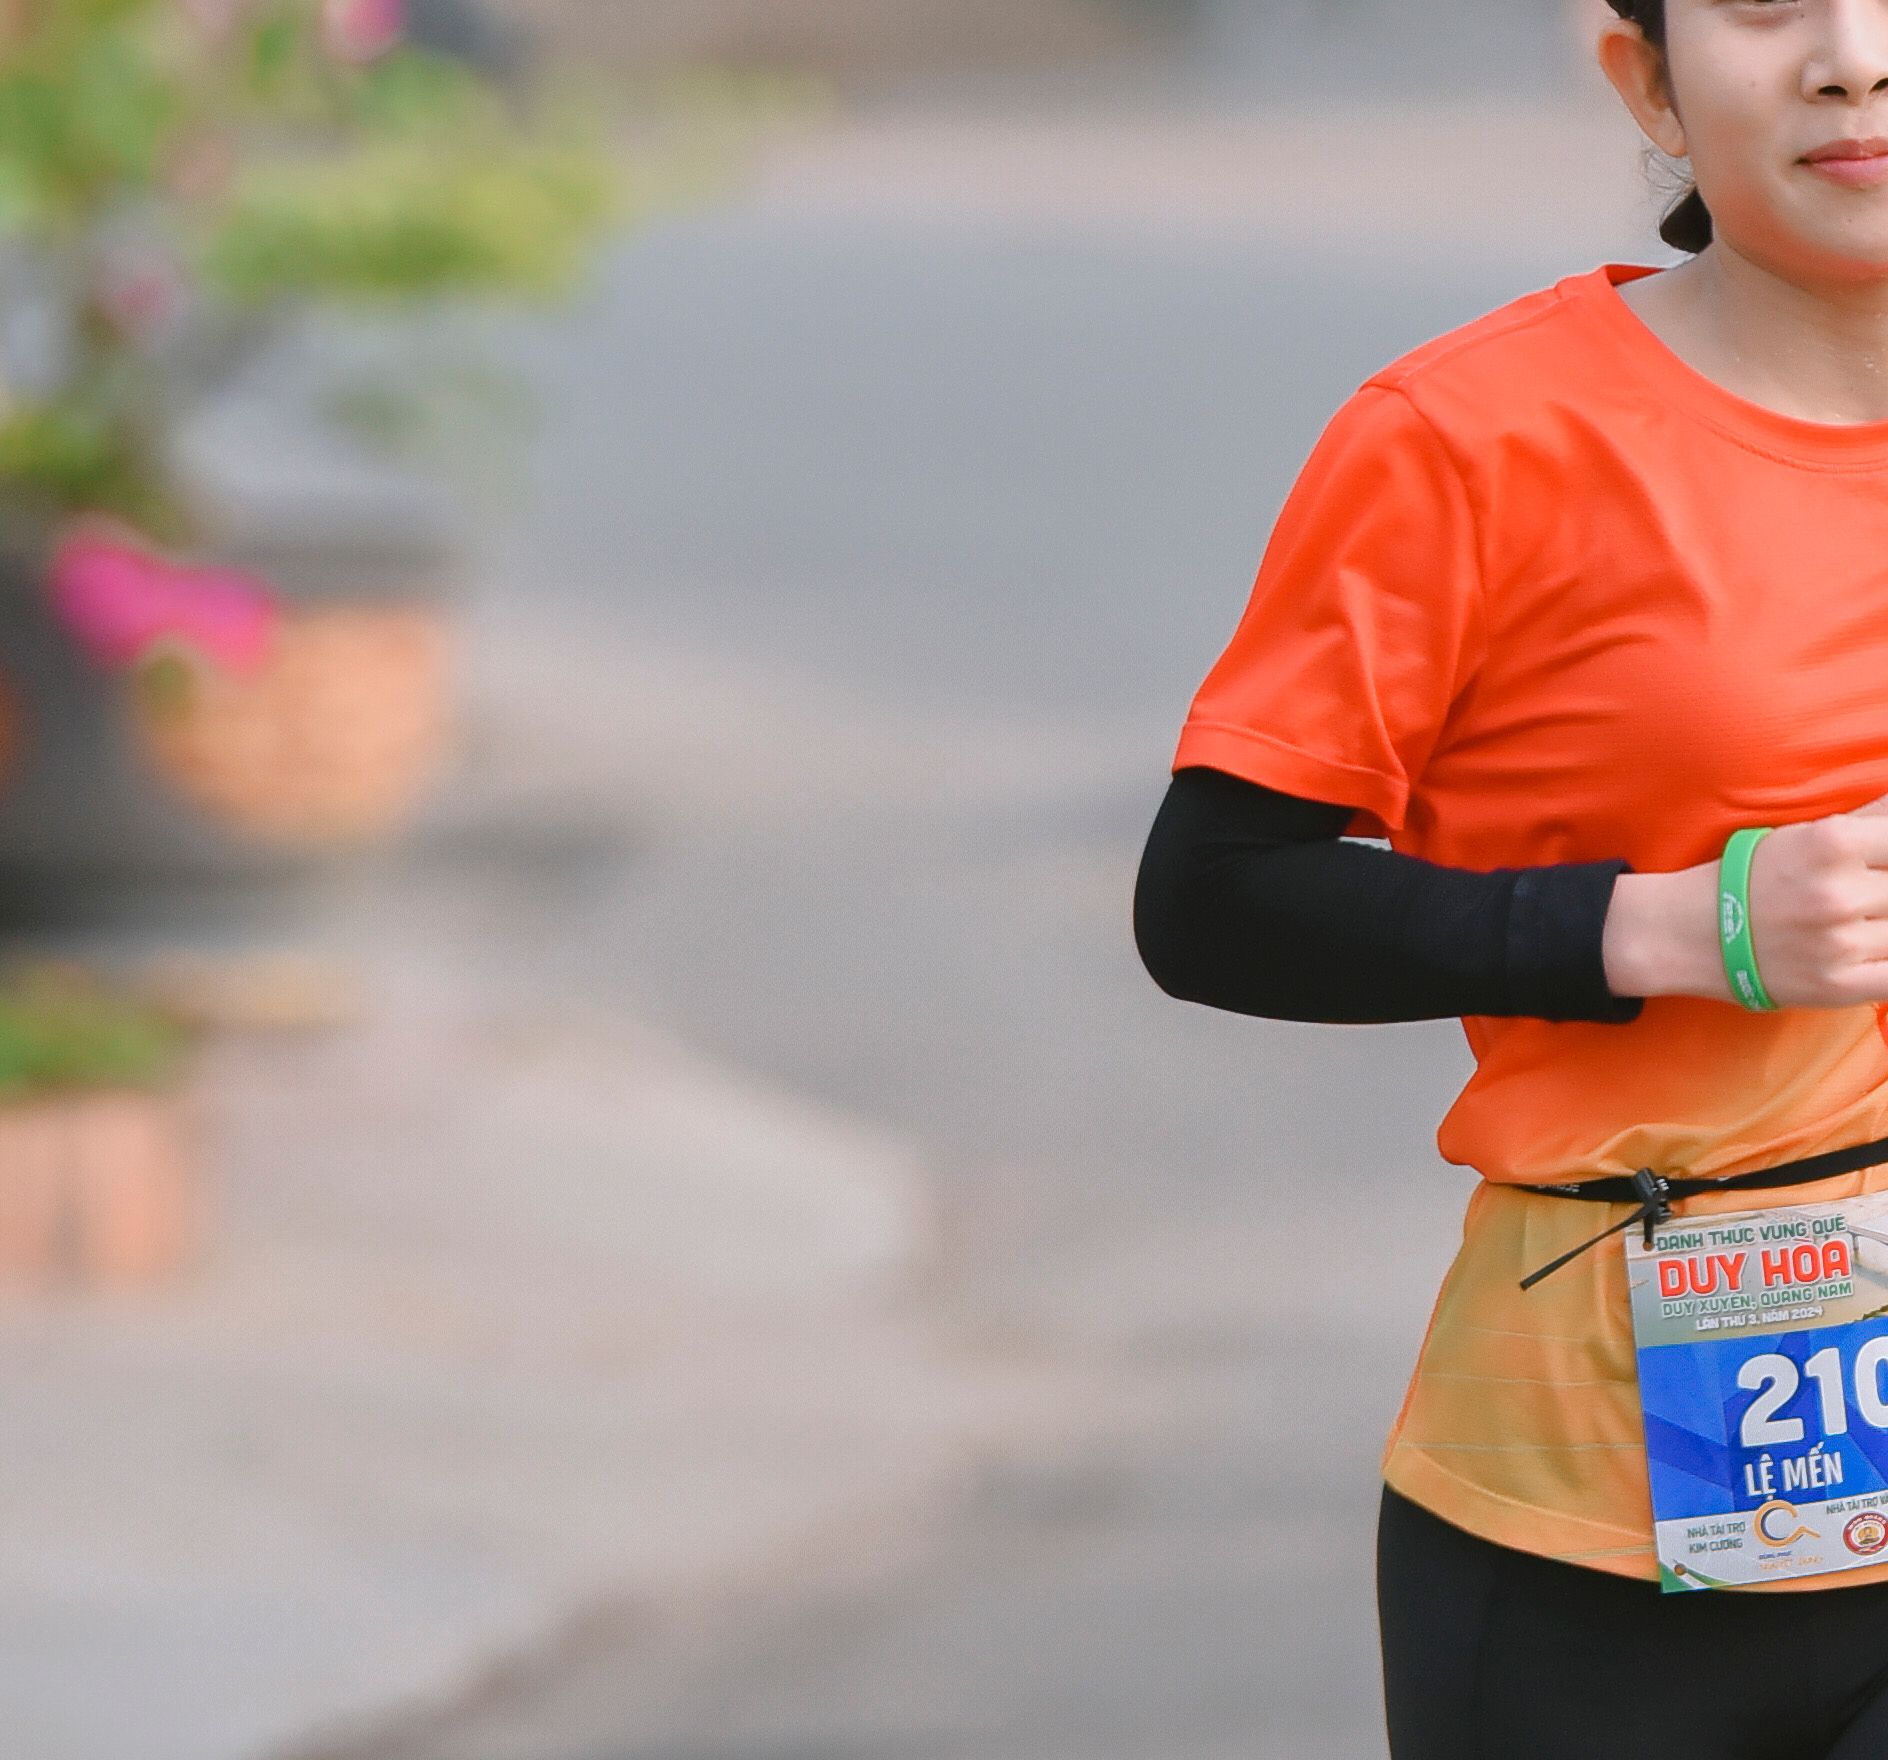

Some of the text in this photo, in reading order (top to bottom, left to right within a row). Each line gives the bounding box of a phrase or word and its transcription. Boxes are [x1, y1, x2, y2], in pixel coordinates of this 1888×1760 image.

[1659, 1253, 1746, 1297] DUY
[1662, 1302, 1694, 1316] DUY
[1818, 1282, 1852, 1297] NAM
[1791, 1306, 1823, 1319] 2024
[1744, 1442, 1844, 1501] LỆ MẾN
